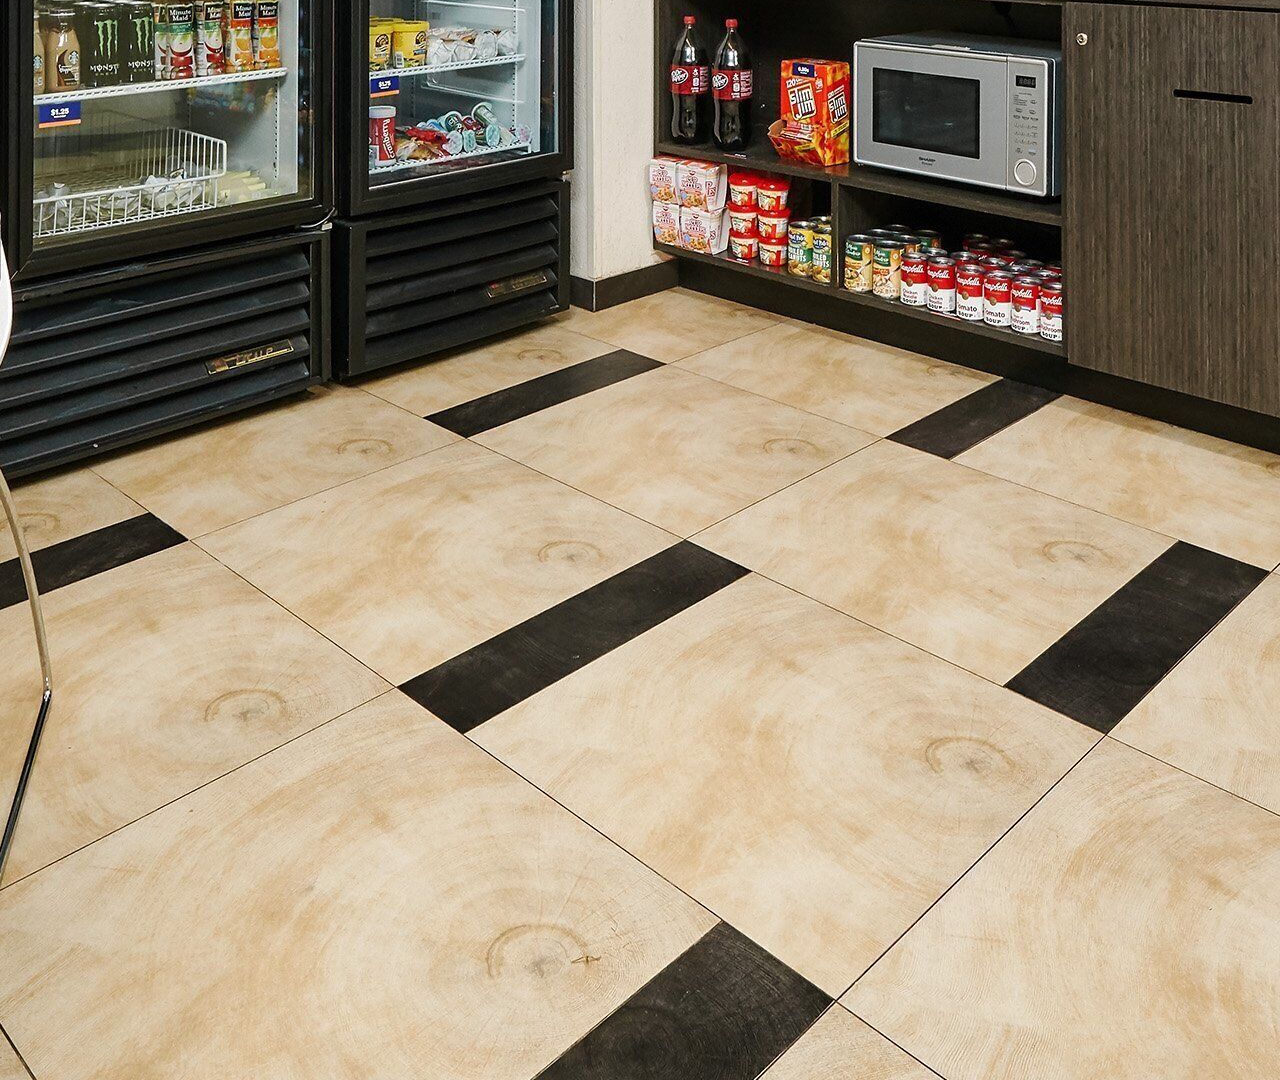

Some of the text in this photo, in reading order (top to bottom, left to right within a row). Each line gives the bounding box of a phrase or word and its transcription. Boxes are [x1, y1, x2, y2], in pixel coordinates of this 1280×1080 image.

[170, 9, 192, 17] Minute
[172, 14, 188, 22] Maid
[786, 79, 796, 88] 120
[51, 108, 70, 116] $1.25
